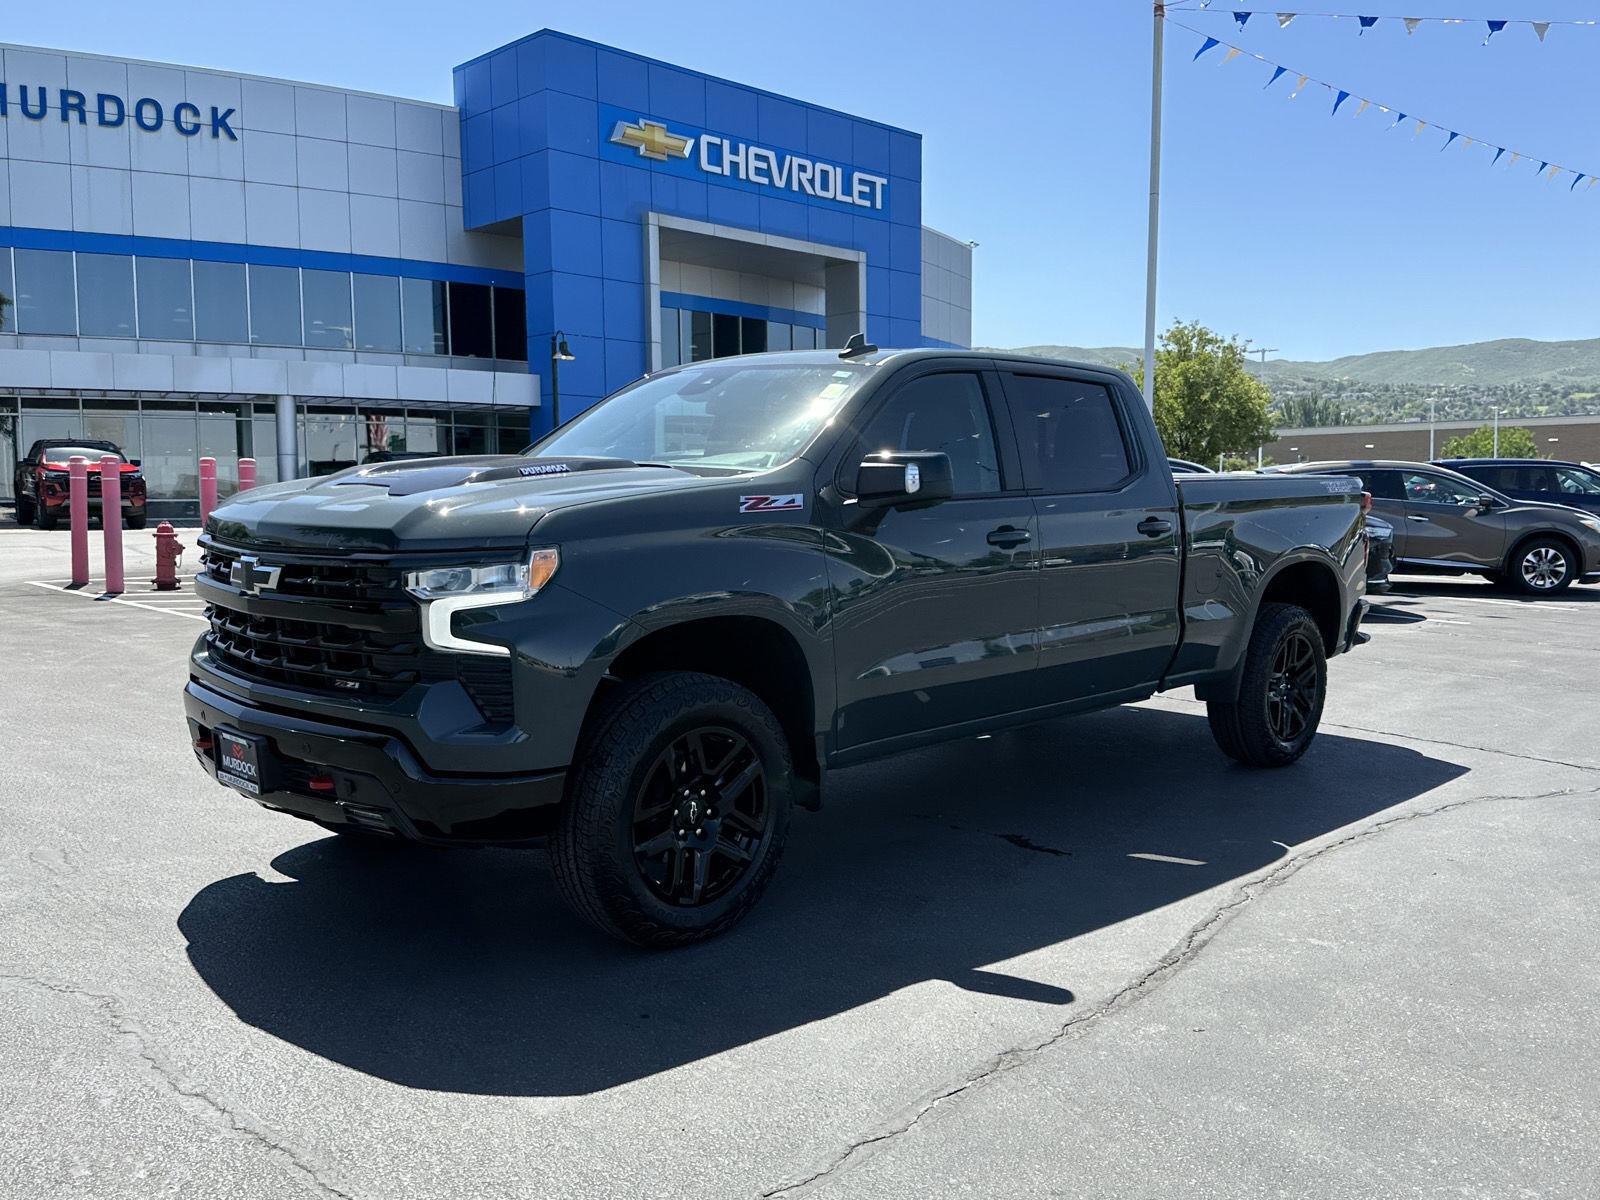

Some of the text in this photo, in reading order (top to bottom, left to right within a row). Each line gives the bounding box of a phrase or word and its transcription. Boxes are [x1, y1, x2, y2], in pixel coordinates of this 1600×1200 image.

[0, 83, 238, 141] URDOCK
[700, 134, 888, 209] CHEVROLET
[519, 464, 570, 475] DURAMAX
[222, 754, 257, 777] MURDOCK
